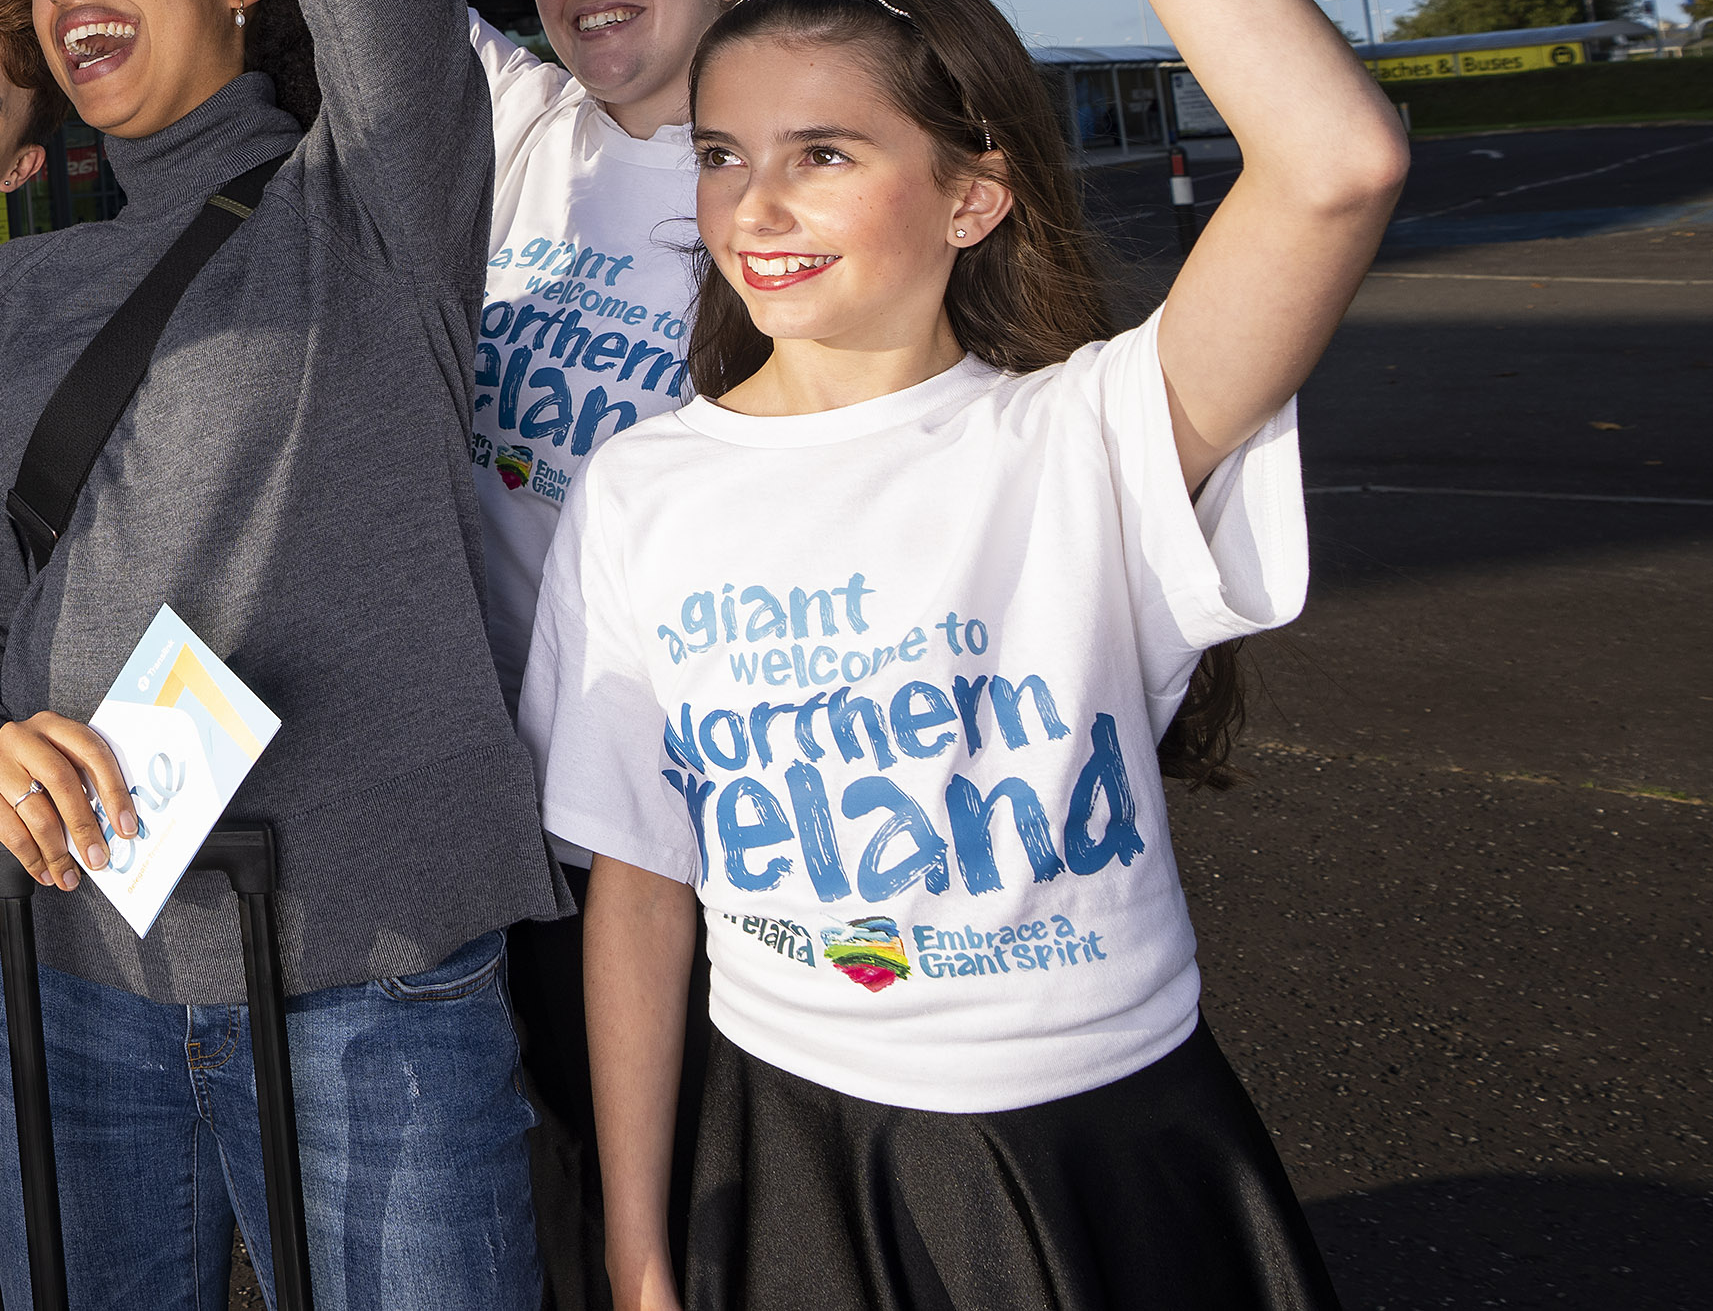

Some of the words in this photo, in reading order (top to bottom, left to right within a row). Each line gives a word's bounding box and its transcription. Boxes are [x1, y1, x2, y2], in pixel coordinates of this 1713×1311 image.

[1463, 56, 1524, 72] Buses
[488, 247, 513, 269] a
[515, 237, 634, 287] giant
[525, 274, 648, 325] welcome
[653, 310, 688, 340] to
[480, 300, 689, 399] orthern
[532, 476, 565, 503] Gian
[657, 624, 687, 665] a
[681, 572, 876, 653] giant
[729, 626, 928, 688] welcome
[936, 611, 989, 656] to
[912, 921, 1048, 953] Embrace
[1050, 914, 1076, 938] a
[919, 944, 1011, 979] Giant
[1011, 930, 1108, 972] Spirit
